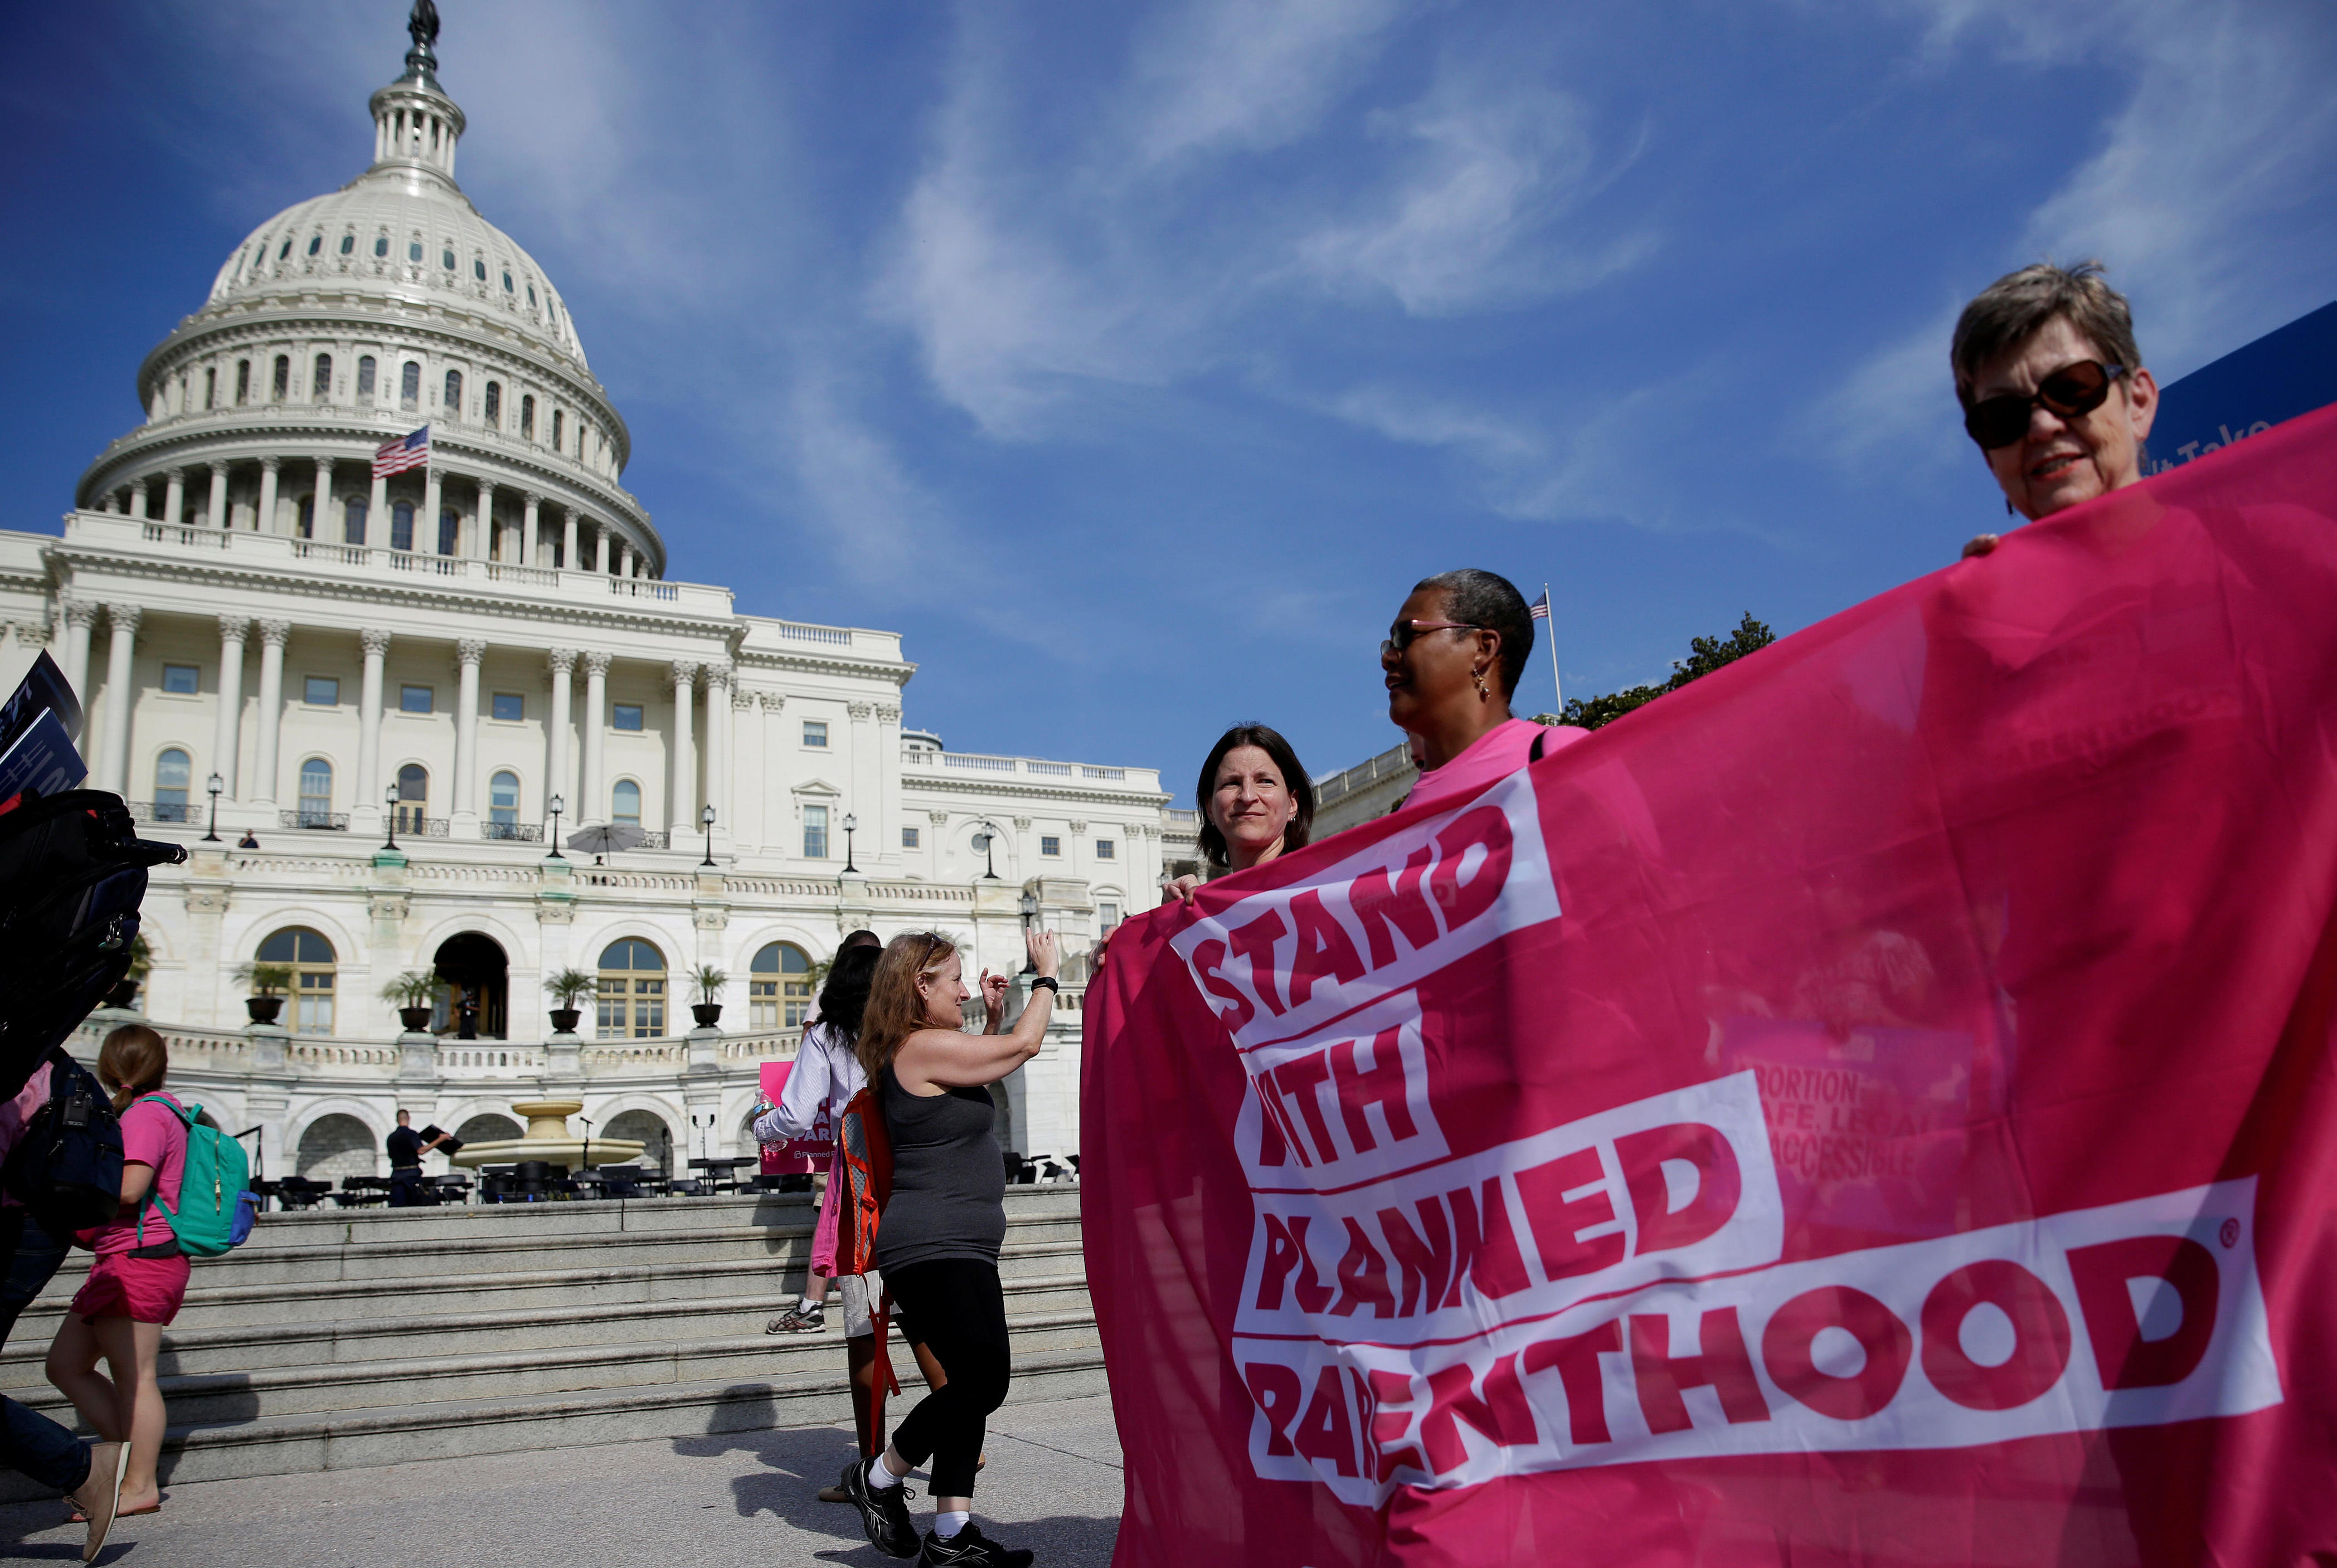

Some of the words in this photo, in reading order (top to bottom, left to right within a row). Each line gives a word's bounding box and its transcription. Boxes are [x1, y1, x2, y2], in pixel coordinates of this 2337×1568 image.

[1192, 806, 1513, 1034] STAND
[1740, 1065, 1859, 1104] BORTION
[1256, 1122, 1741, 1319] PLANNED
